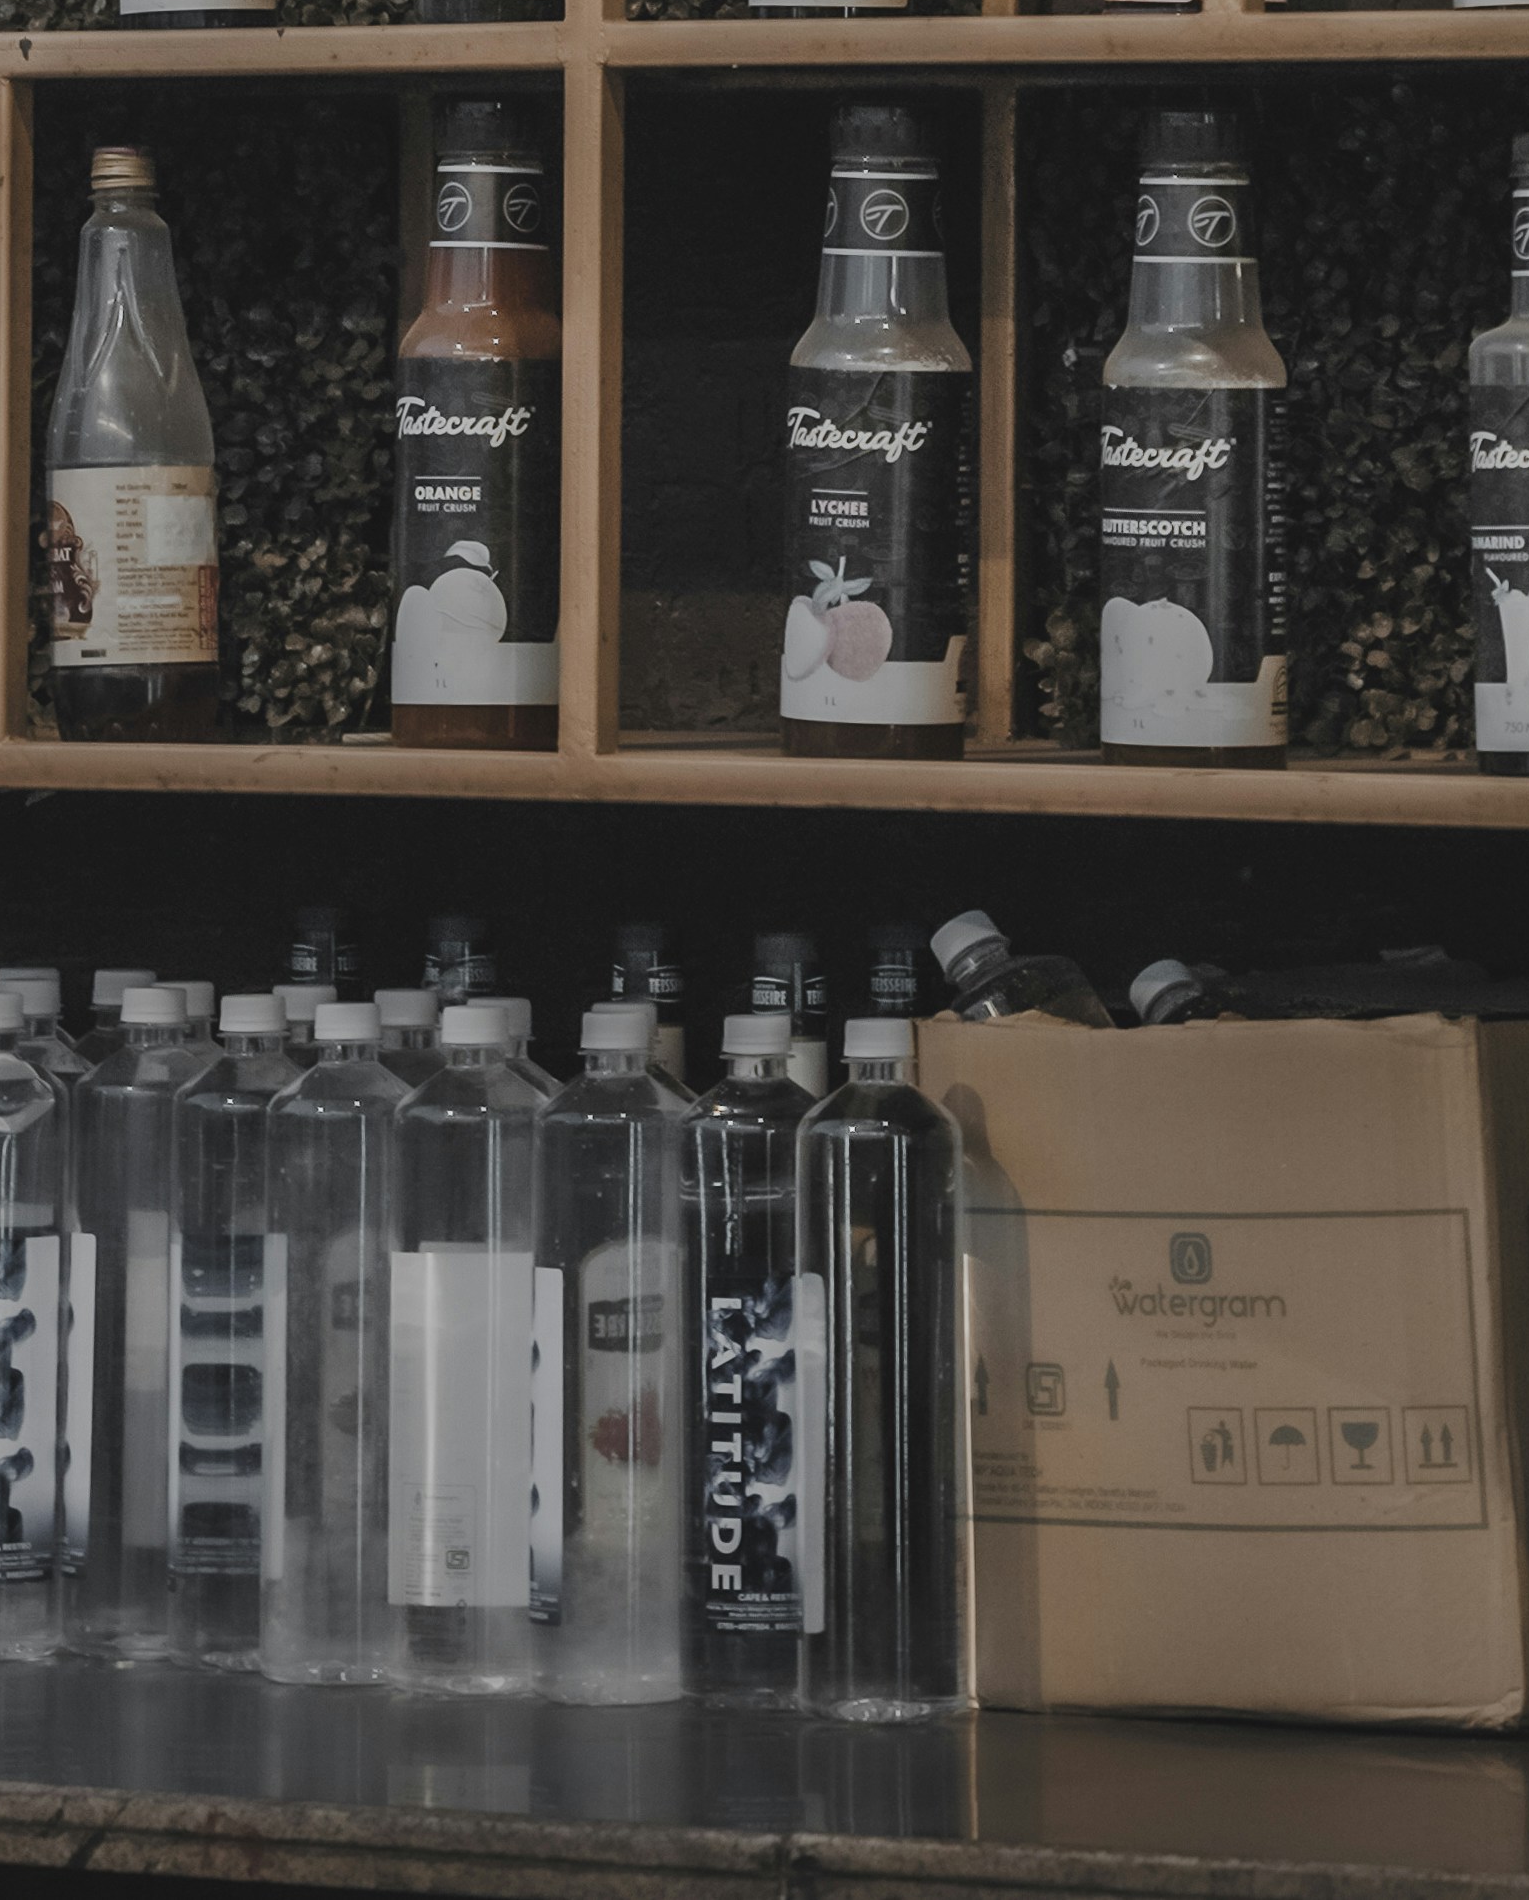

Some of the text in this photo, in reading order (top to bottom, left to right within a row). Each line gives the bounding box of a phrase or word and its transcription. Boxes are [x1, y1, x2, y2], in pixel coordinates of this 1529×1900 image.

[396, 396, 531, 448] Tastecraft
[787, 406, 928, 464] Tastecraft
[1100, 425, 1232, 481] Tastecraft
[415, 486, 482, 501] ORANGE
[417, 502, 477, 513] FRUIT CRUSH
[810, 499, 869, 517] LYCHEE
[809, 516, 871, 529] FRUIT CRUSH
[1139, 536, 1167, 548] FRUIT
[1169, 537, 1207, 549] CRUSH
[1504, 721, 1523, 733] 750
[1112, 1283, 1288, 1328] watergram
[710, 1296, 743, 1592] LATITUDE
